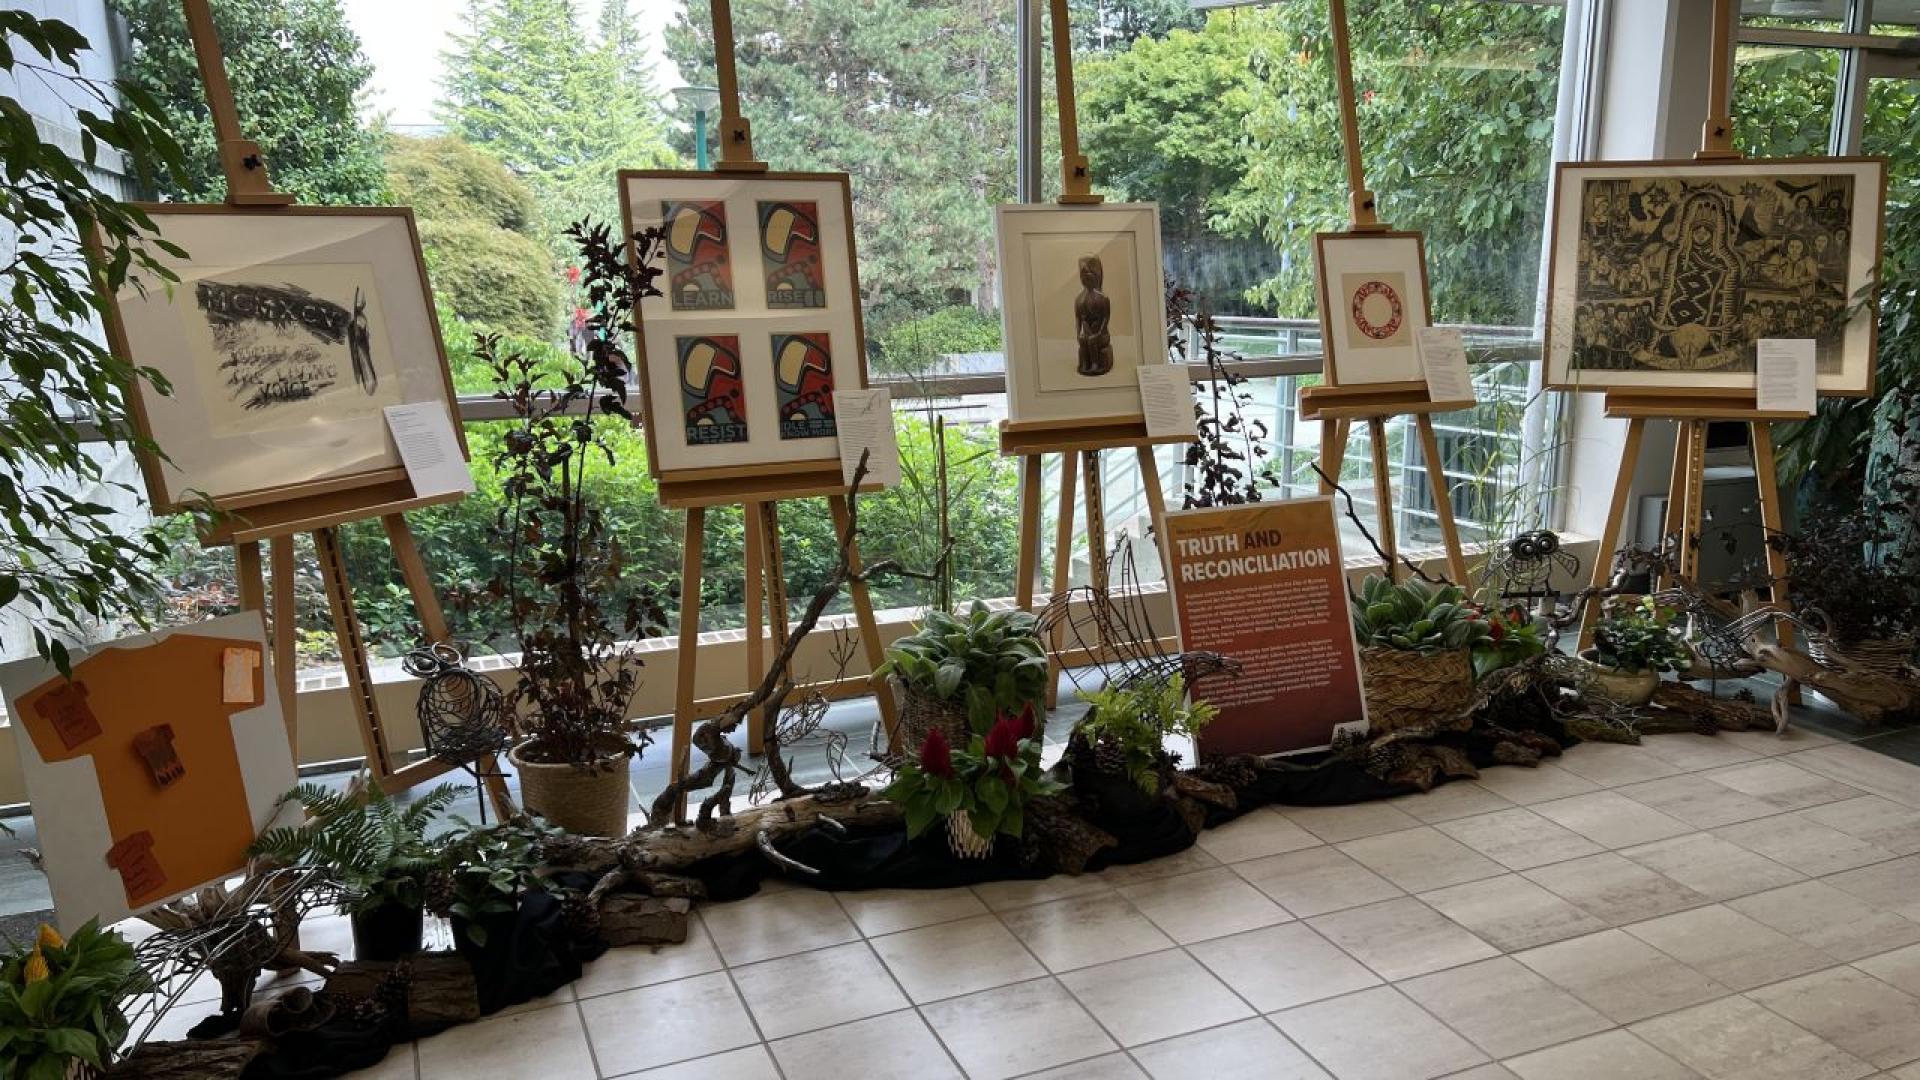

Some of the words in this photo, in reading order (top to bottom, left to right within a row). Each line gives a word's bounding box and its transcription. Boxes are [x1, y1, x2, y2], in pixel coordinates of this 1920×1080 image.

[672, 289, 735, 307] LEARN
[767, 290, 804, 304] RISE
[686, 423, 746, 441] RESIST
[1177, 533, 1240, 558] TRUTH
[1244, 528, 1282, 550] AND
[1181, 548, 1331, 583] RECONCILIATION
